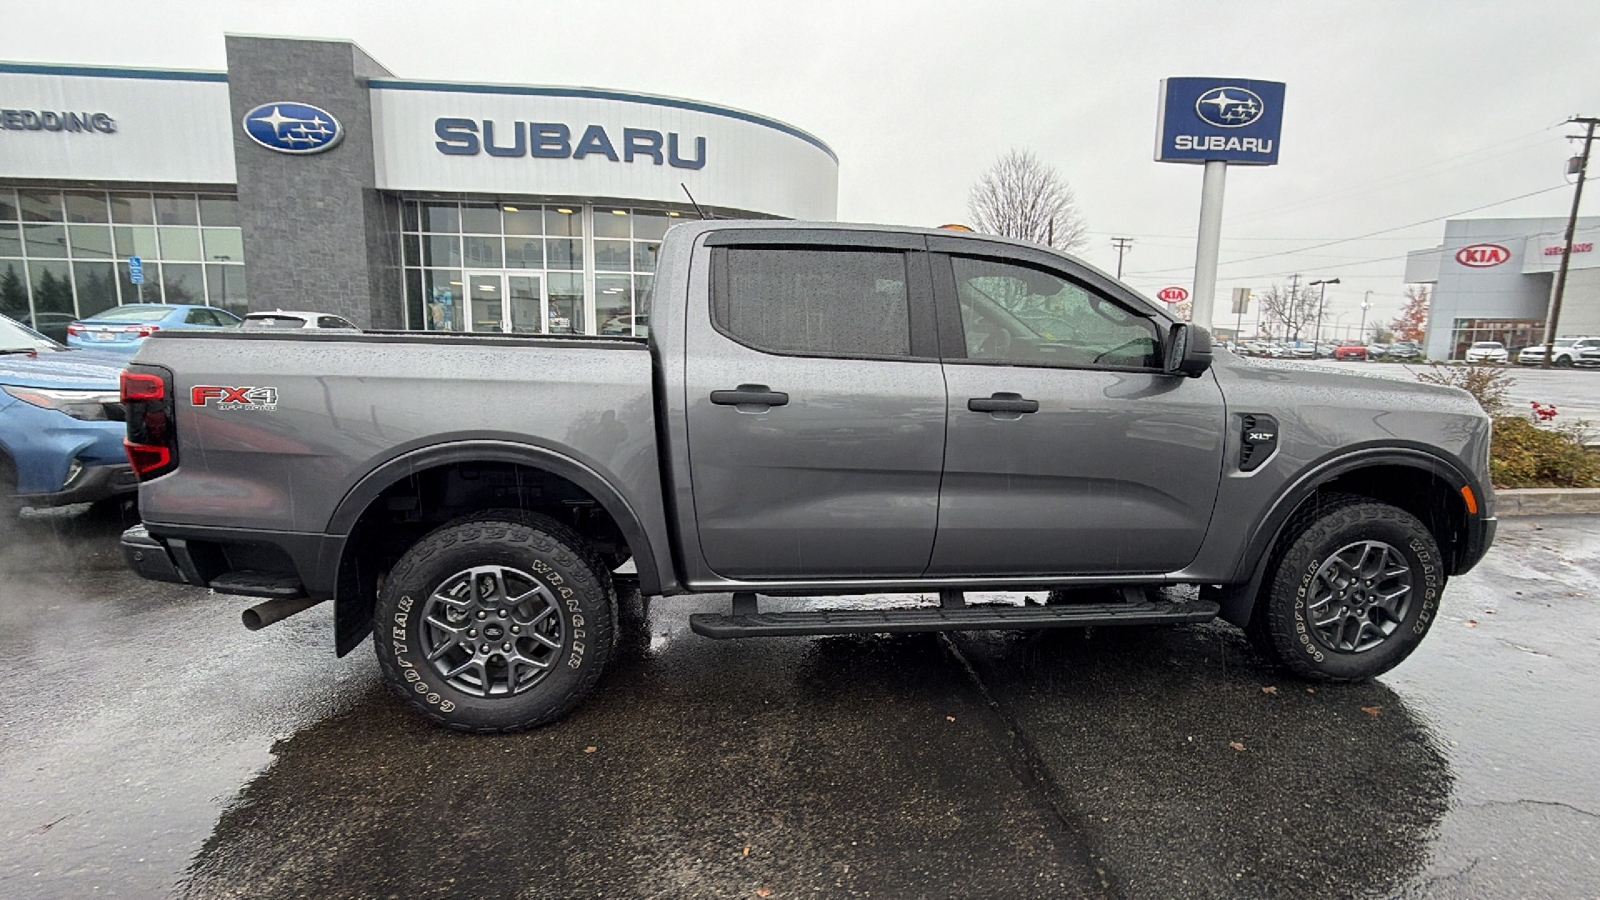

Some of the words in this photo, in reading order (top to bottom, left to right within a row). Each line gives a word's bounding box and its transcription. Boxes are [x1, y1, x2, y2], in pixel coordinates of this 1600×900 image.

[0, 109, 116, 133] EDDING
[435, 118, 706, 170] SUBARU
[1175, 135, 1272, 153] SUBARU
[1465, 249, 1501, 262] KIA
[1164, 290, 1184, 300] KIA
[190, 385, 278, 406] FX4
[1249, 432, 1274, 440] XLT
[1409, 538, 1436, 634] WRANGLER
[532, 559, 586, 669] WRANGLER
[1294, 559, 1324, 663] GOODYEAR
[392, 595, 456, 713] GOODYEAR
